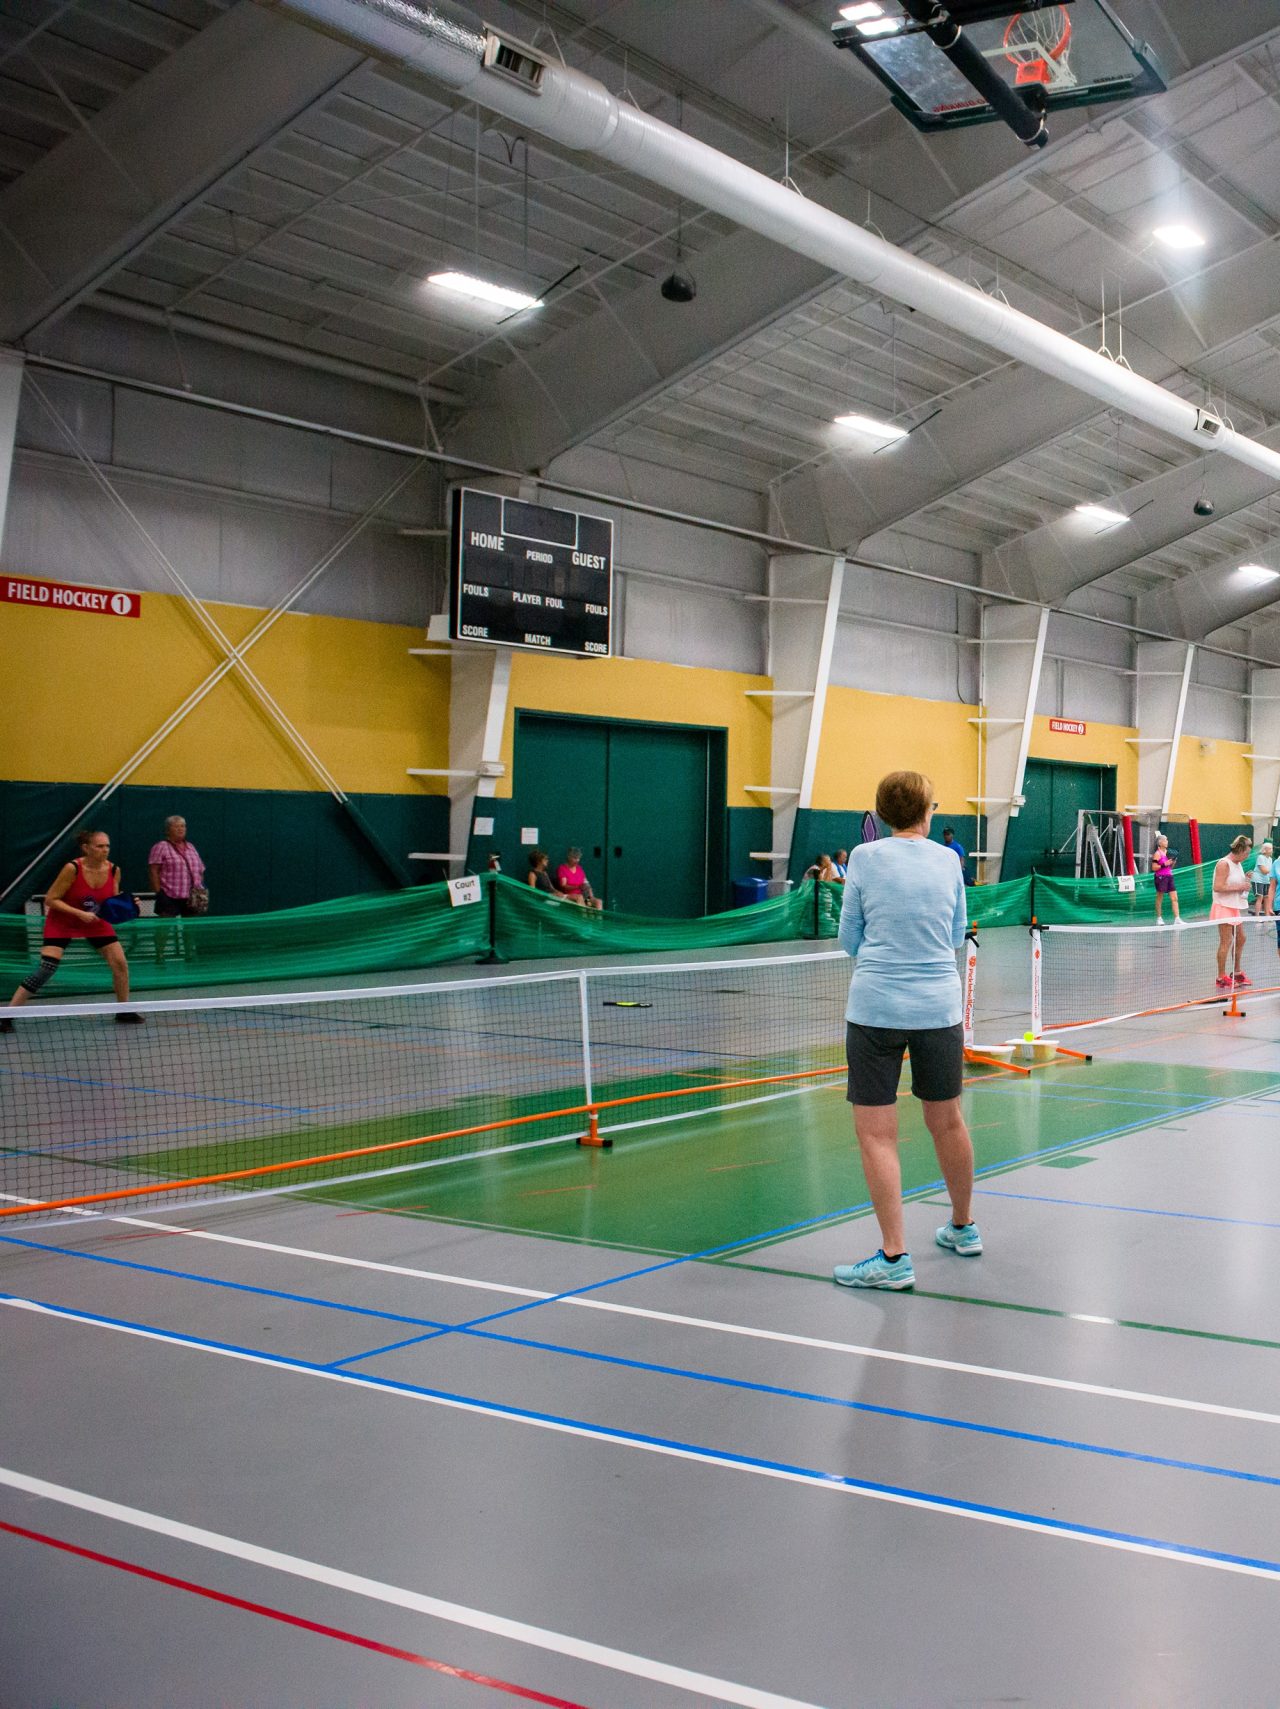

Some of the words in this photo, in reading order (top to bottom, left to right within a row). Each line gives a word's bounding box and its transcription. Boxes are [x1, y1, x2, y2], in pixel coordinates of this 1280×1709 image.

[470, 531, 505, 551] HOME
[526, 550, 553, 564] PERIOD
[571, 551, 607, 571] GUEST
[7, 582, 49, 602] FIELD
[52, 588, 108, 610] HOCKEY
[462, 583, 489, 598] FOULS
[512, 591, 542, 606] PLAYER
[545, 597, 565, 610] FOUL
[584, 603, 609, 617] FOULS
[462, 624, 489, 638] SCORE
[524, 633, 551, 646] MATCH
[584, 641, 608, 654] SCORE
[1052, 721, 1062, 731] FIELD
[455, 880, 475, 889] Court
[463, 893, 472, 901] #2
